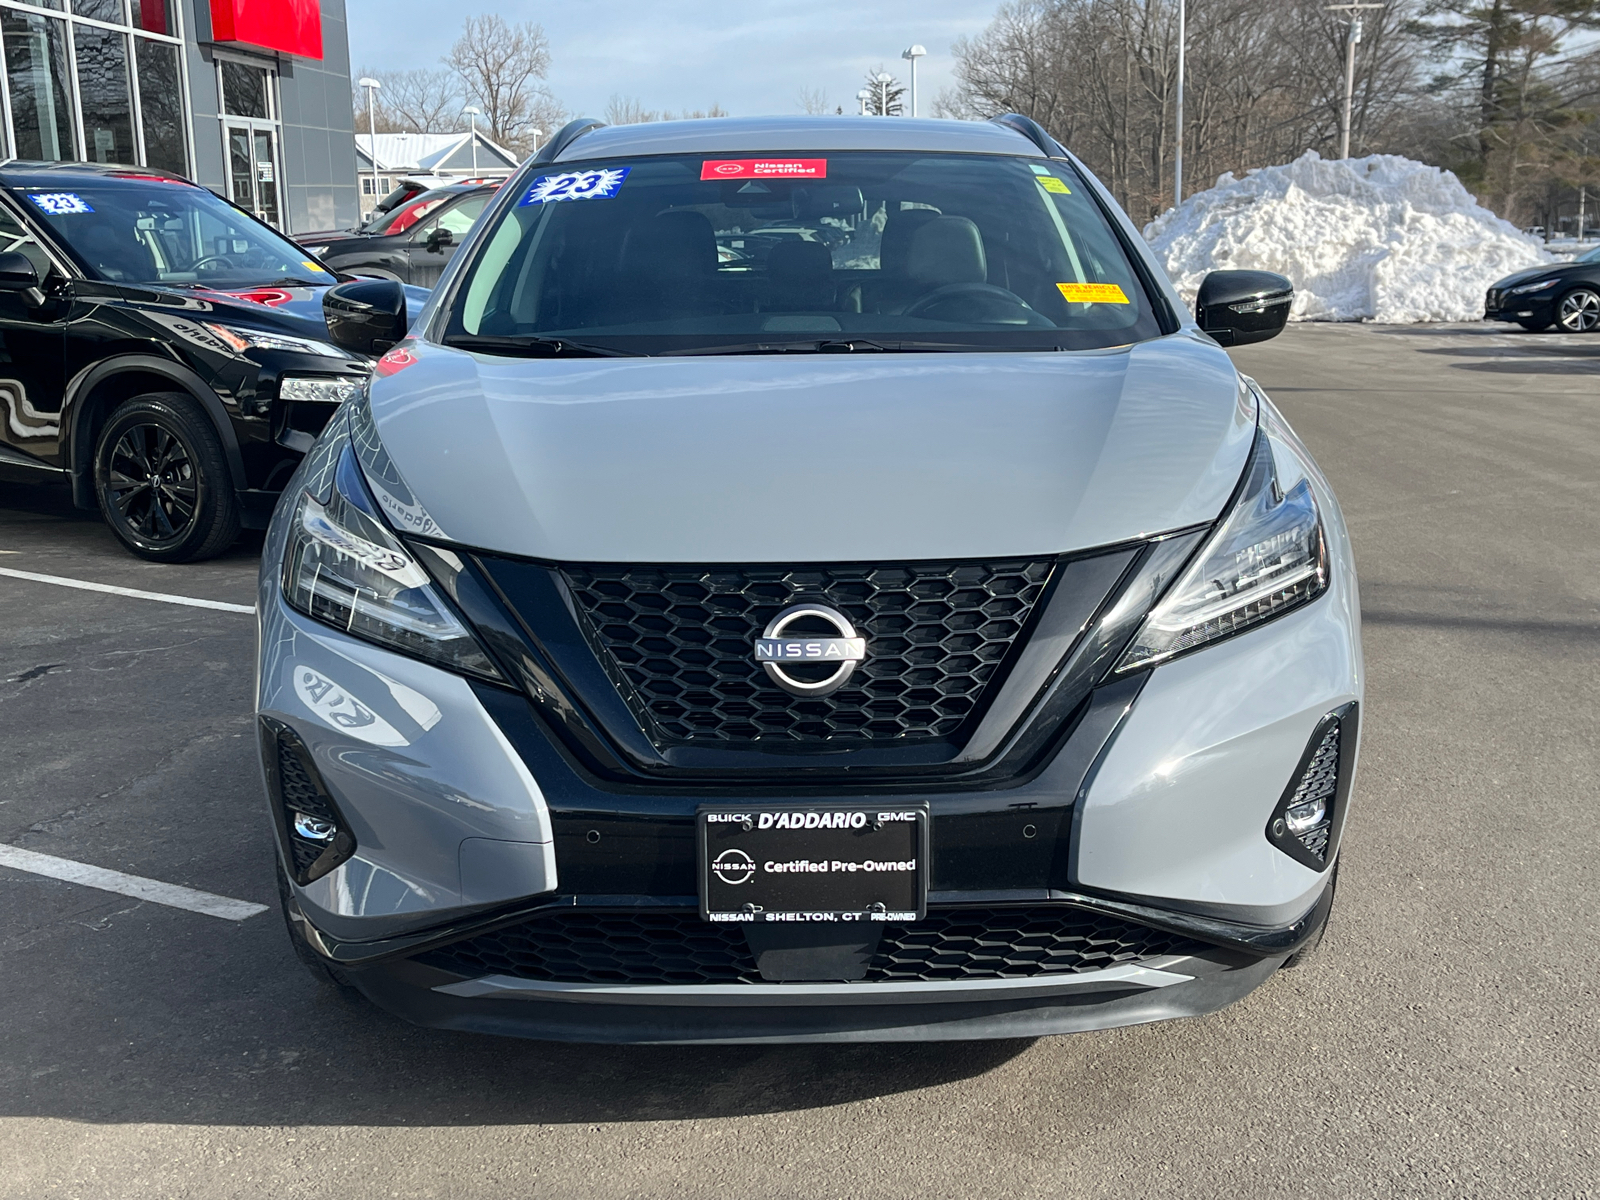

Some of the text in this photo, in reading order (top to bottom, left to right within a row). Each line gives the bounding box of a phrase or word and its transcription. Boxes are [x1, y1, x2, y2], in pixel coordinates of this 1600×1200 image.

[546, 174, 603, 196] 23
[46, 197, 76, 209] 23
[757, 643, 862, 657] NISSAN
[707, 812, 916, 829] BUICK D'ADDARIO GMC
[763, 858, 916, 872] Certified Pre-Owned
[709, 912, 917, 922] NISSAN SHELTON, CT PRE-OWNED
